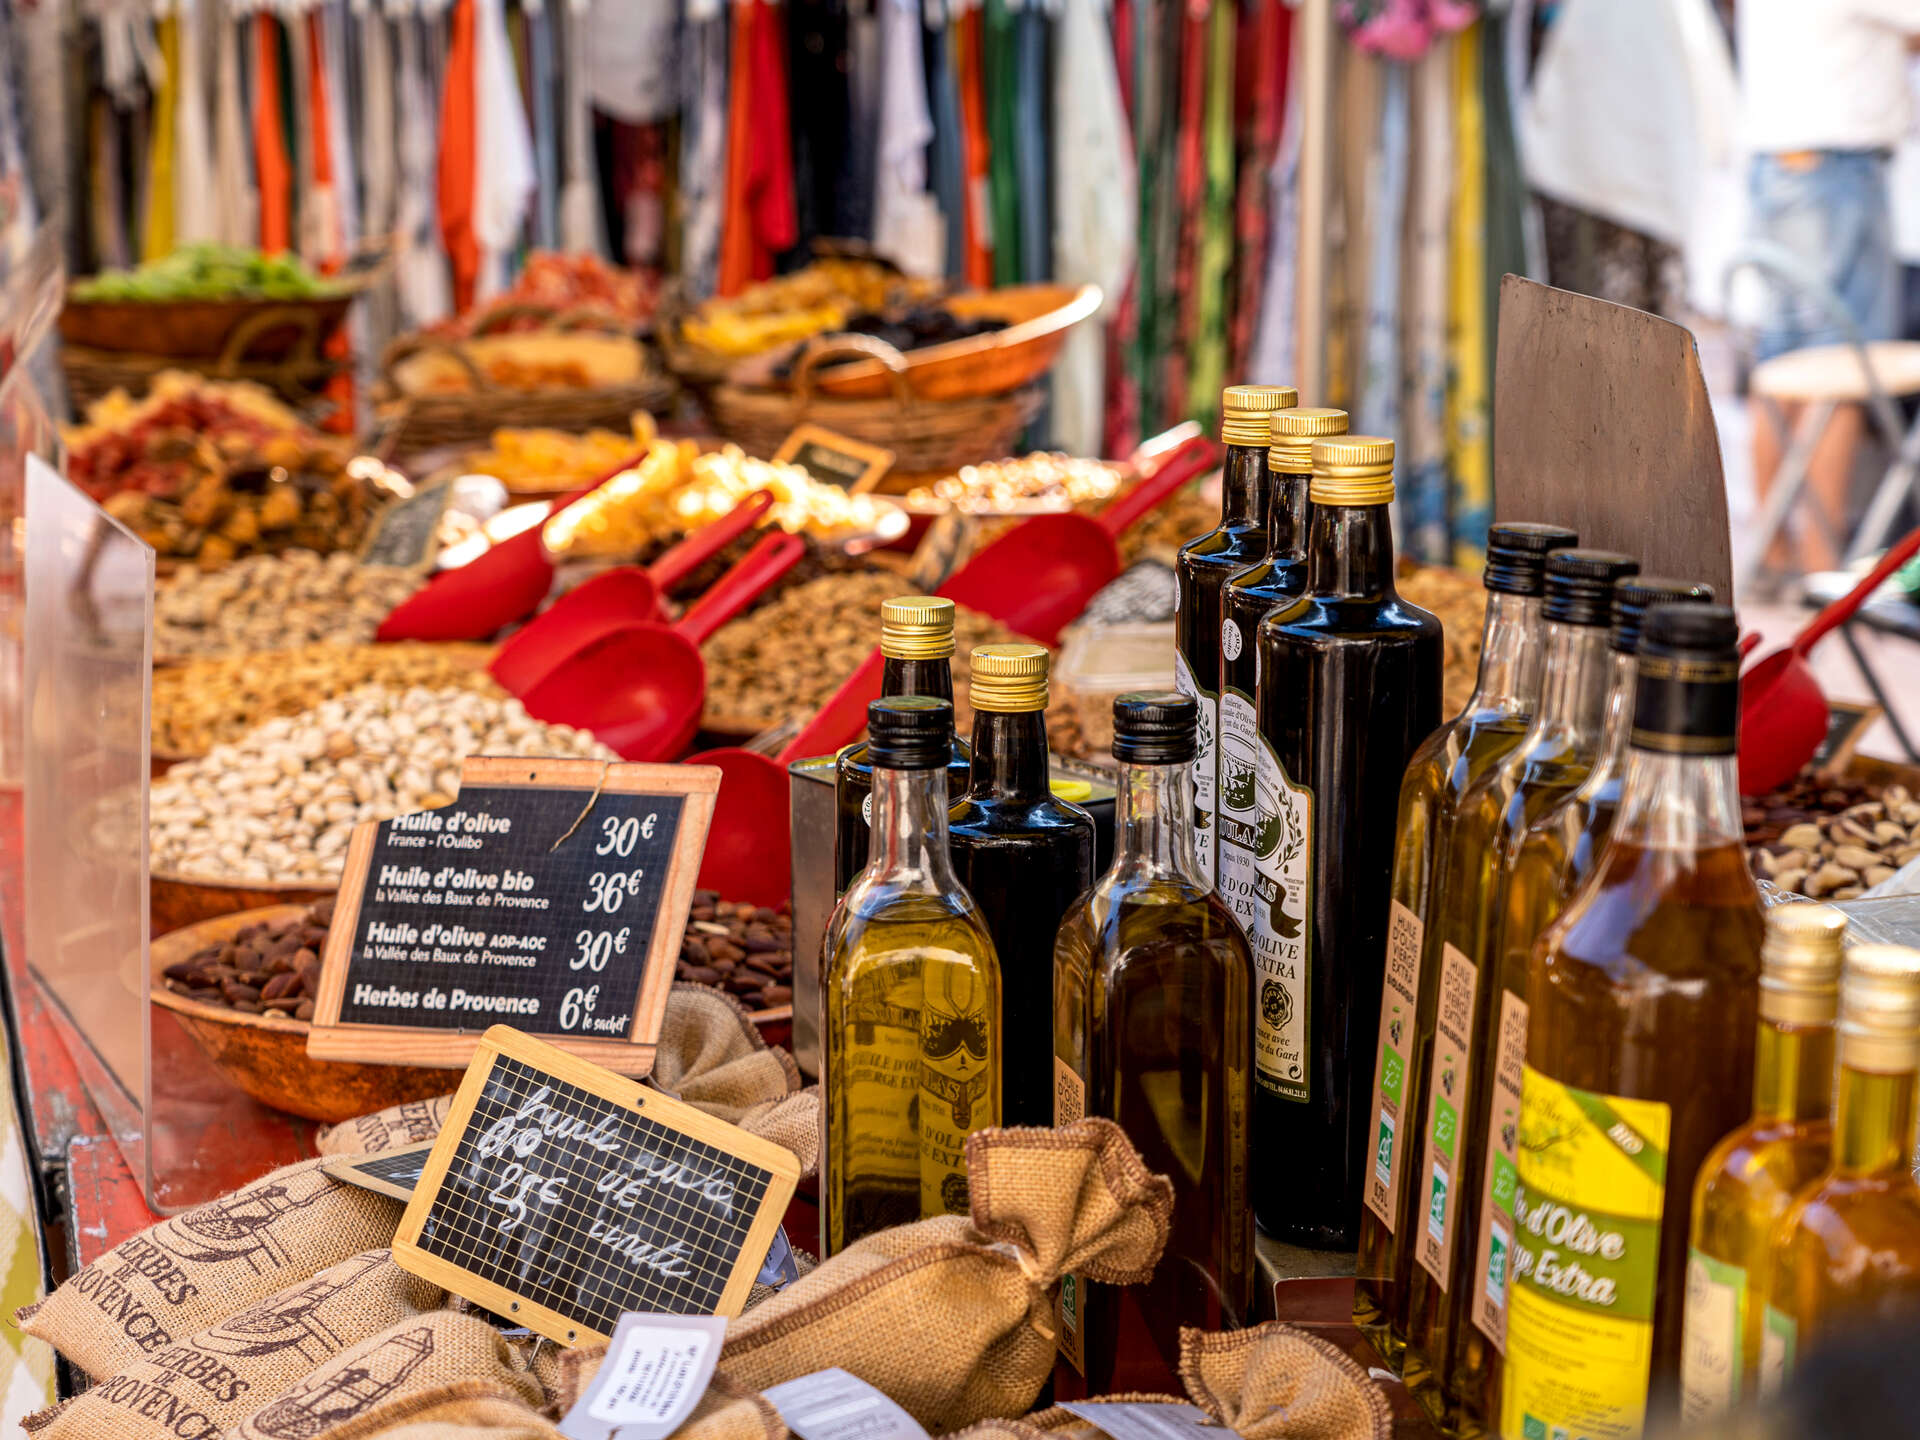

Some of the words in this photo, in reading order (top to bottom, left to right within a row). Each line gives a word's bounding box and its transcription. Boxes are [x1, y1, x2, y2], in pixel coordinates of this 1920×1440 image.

[387, 832, 426, 847] France
[436, 833, 483, 849] l'Oulibo
[391, 811, 443, 832] Huile
[446, 811, 512, 834] d'olive
[596, 813, 657, 857] 30€
[1236, 853, 1250, 867] 1930
[375, 888, 385, 902] la
[387, 888, 420, 903] Vallée
[422, 890, 442, 904] des
[444, 890, 473, 906] Baux
[476, 892, 491, 907] de
[493, 892, 550, 909] Provence
[379, 865, 431, 888] Huile
[433, 867, 499, 890] d'olive
[501, 869, 534, 892] bio
[582, 869, 643, 914] 36€
[363, 944, 373, 959] la
[375, 945, 407, 961] Vallée
[410, 947, 430, 962] des
[432, 948, 461, 963] Baux
[464, 949, 479, 964] de
[481, 951, 537, 967] Provence
[366, 921, 419, 945] Huile
[421, 924, 486, 947] d'olive
[489, 934, 547, 950] AOP-AOC
[569, 927, 631, 972] 30€
[1256, 952, 1296, 979] EXTRA
[353, 984, 419, 1008] Herbes
[422, 987, 446, 1010] de
[450, 988, 540, 1014] Provence
[559, 984, 600, 1030] 6€
[582, 1013, 593, 1031] le
[594, 1014, 631, 1034] sachet
[1272, 1031, 1290, 1047] avec
[1275, 1047, 1299, 1062] Gard
[1607, 1121, 1644, 1155] BIO
[1527, 1201, 1625, 1260] d'Olive
[113, 1262, 137, 1284] DE
[1534, 1249, 1617, 1306] Extra
[152, 1370, 181, 1388] DE
